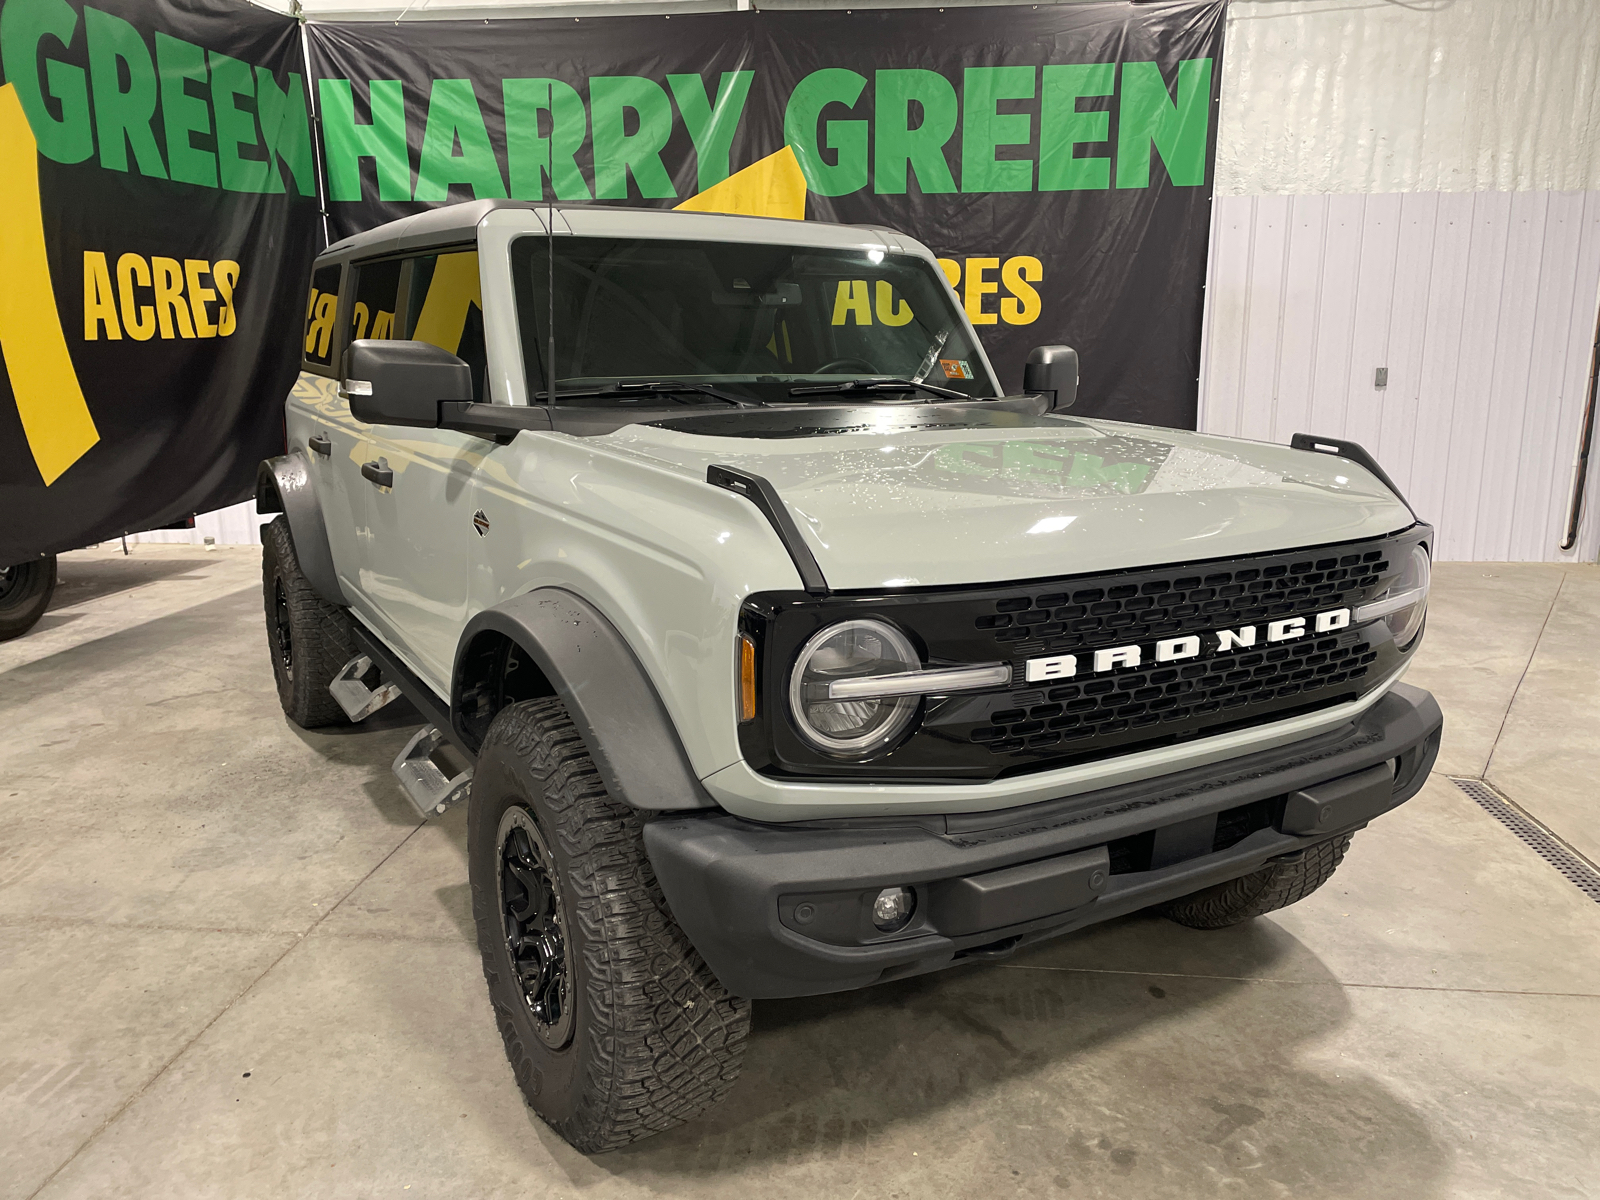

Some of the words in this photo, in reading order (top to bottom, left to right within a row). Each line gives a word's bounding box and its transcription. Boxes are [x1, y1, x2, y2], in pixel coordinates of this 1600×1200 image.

[3, 0, 316, 198] GREEN
[318, 71, 755, 202] HARRY
[784, 58, 1213, 198] GREEN
[83, 251, 241, 341] ACRES
[1026, 608, 1351, 683] BRONCO
